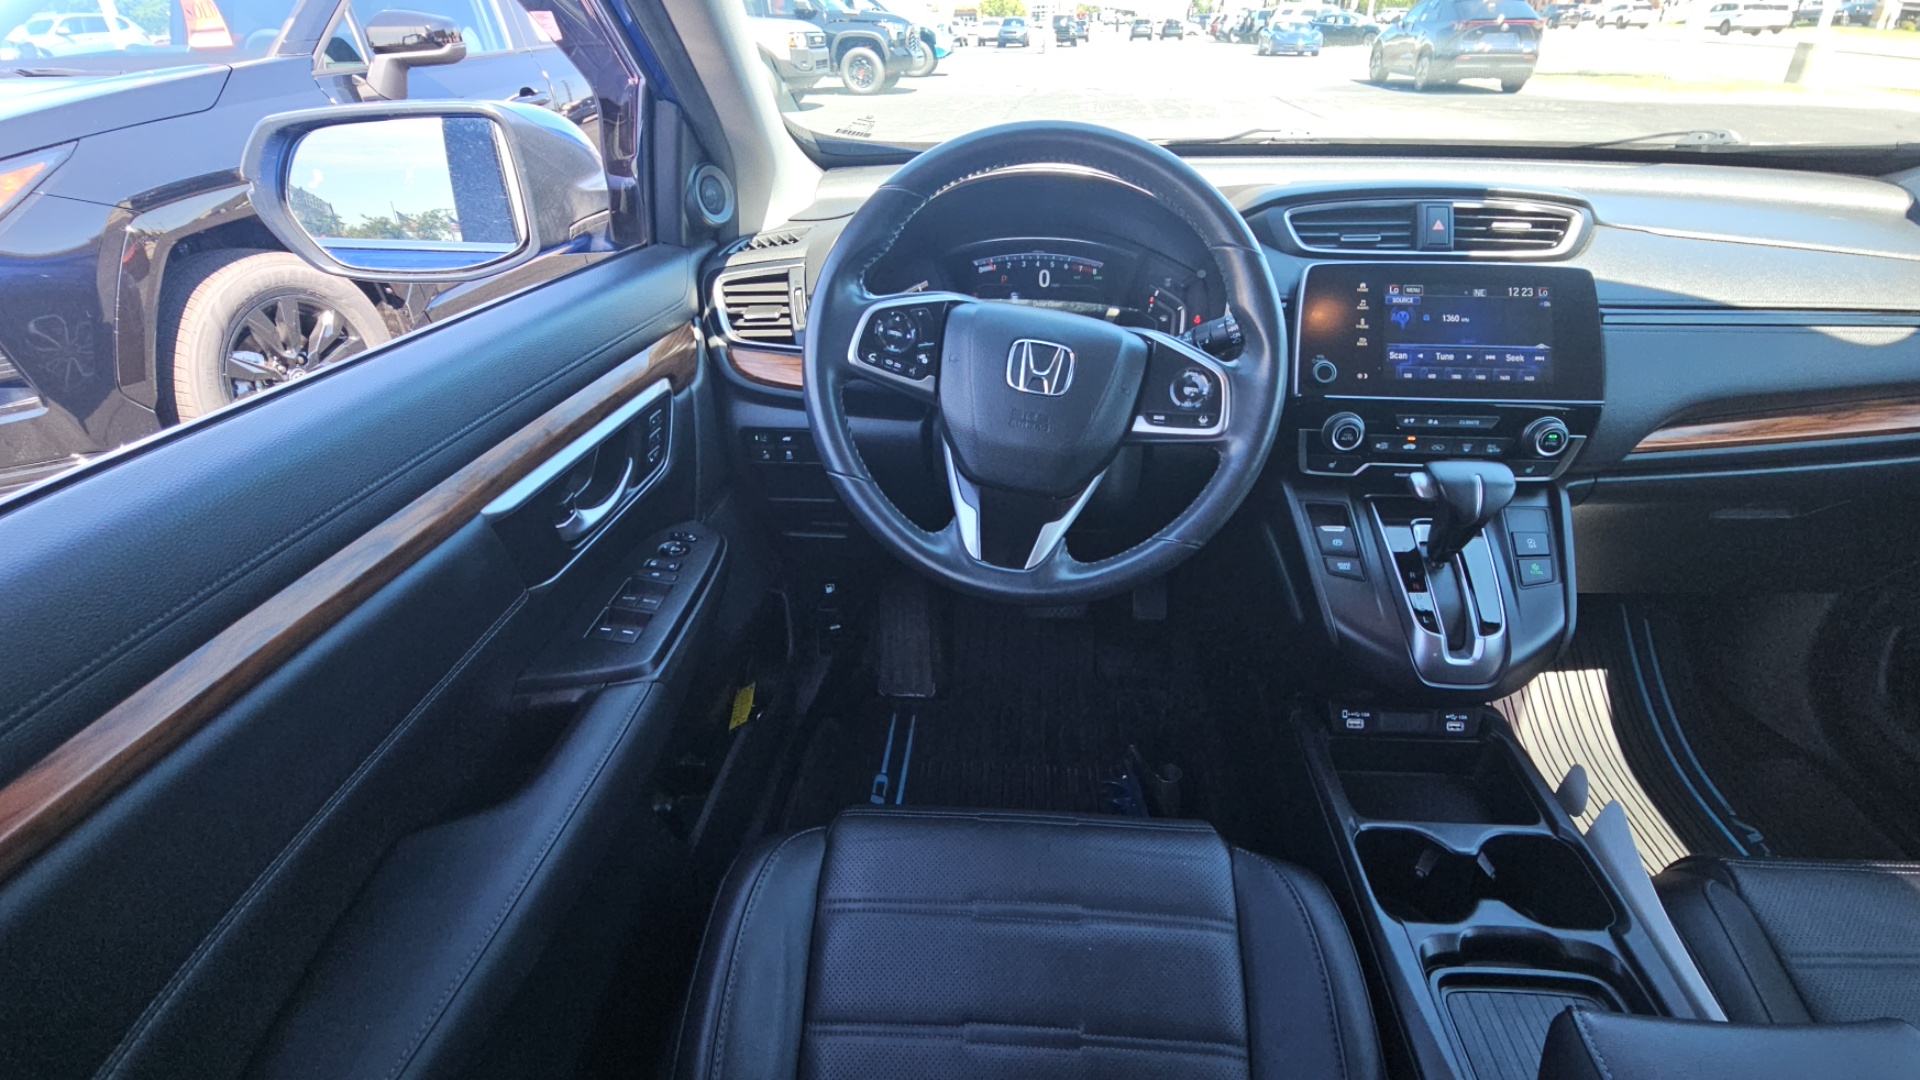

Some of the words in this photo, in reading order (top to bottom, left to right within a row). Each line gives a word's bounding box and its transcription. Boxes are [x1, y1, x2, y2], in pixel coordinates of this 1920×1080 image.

[184, 0, 217, 20] SOLD
[1038, 269, 1050, 288] 0
[1442, 314, 1460, 323] 1360
[1389, 351, 1408, 360] Scan
[1436, 352, 1454, 361] Tune
[1506, 353, 1525, 363] Seek
